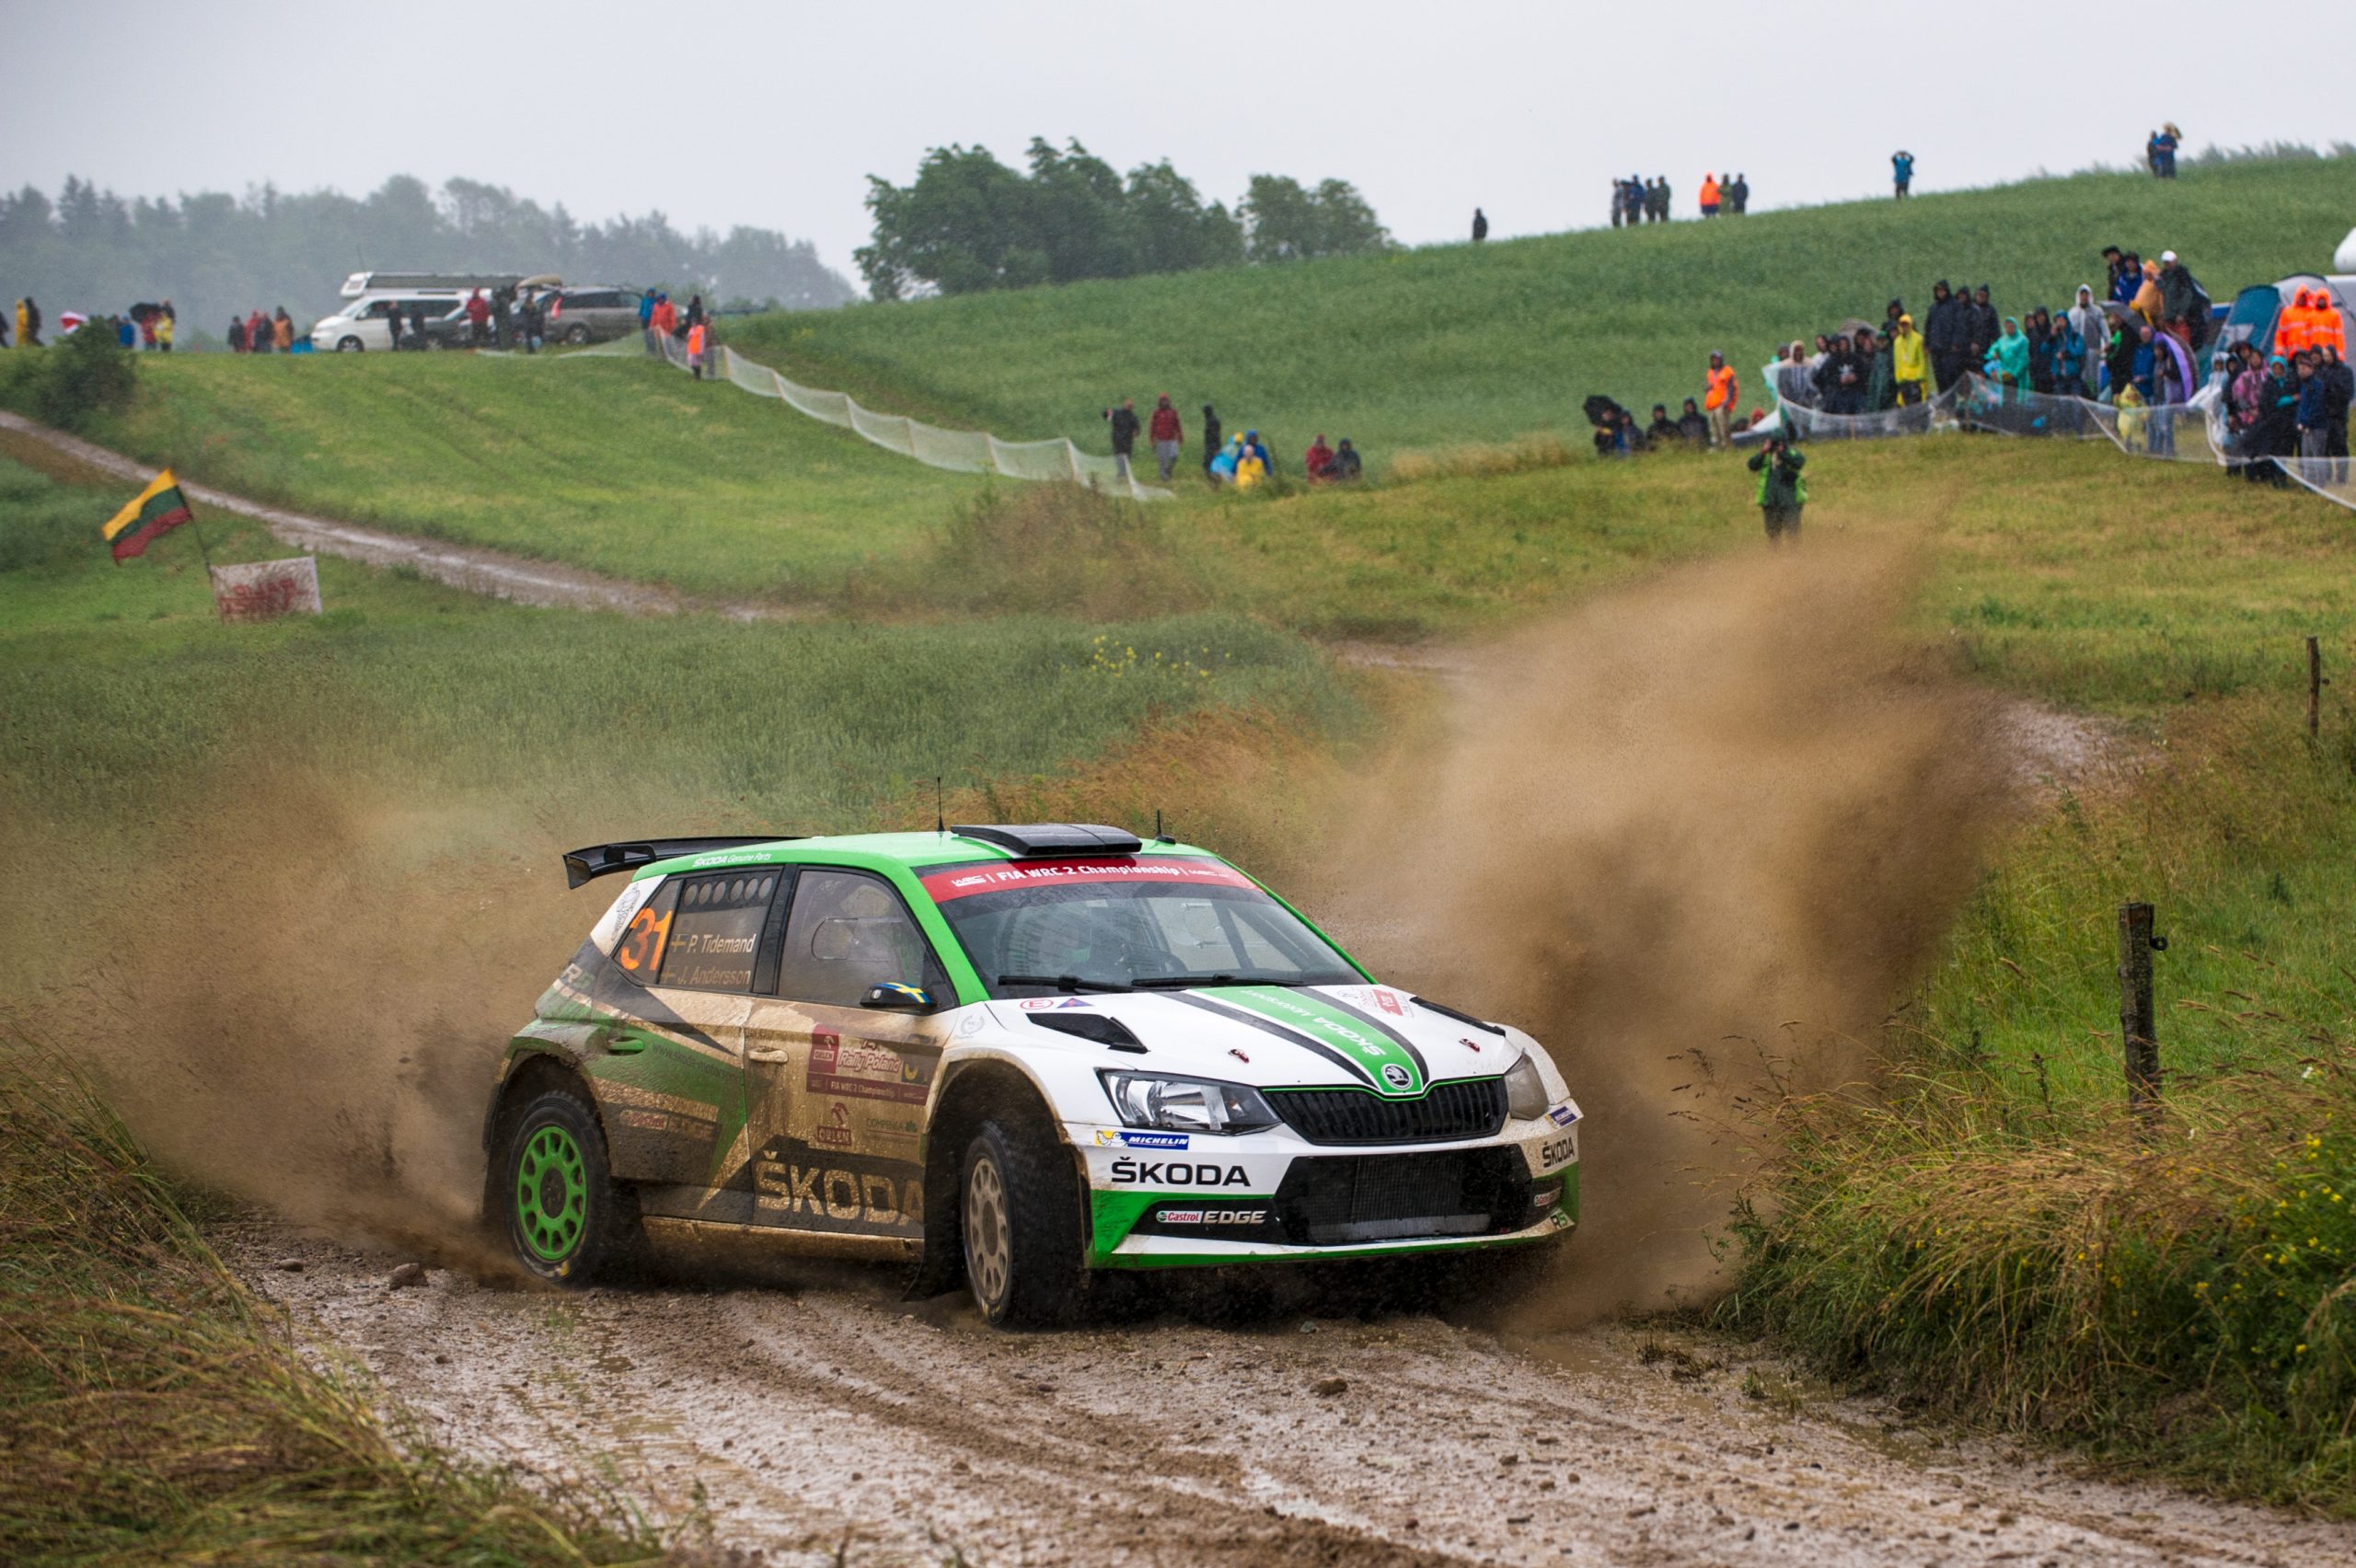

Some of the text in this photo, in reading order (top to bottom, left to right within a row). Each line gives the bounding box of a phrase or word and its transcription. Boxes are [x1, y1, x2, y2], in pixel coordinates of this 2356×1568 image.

[997, 870, 1027, 881] FIA
[1024, 867, 1064, 878] WRC
[1063, 866, 1078, 875] 2
[1077, 865, 1180, 876] Championship
[620, 907, 673, 972] 31
[686, 933, 756, 954] P. Tidemand
[677, 966, 752, 986] J. Andersson
[837, 1051, 901, 1074] Rally Poland
[1128, 1136, 1189, 1145] MICHELIN
[1542, 1136, 1576, 1169] ŠKODA
[1111, 1156, 1252, 1187] ŠKODA
[756, 1150, 925, 1227] ŠKODA
[1167, 1210, 1267, 1224] Castrol EDGE
